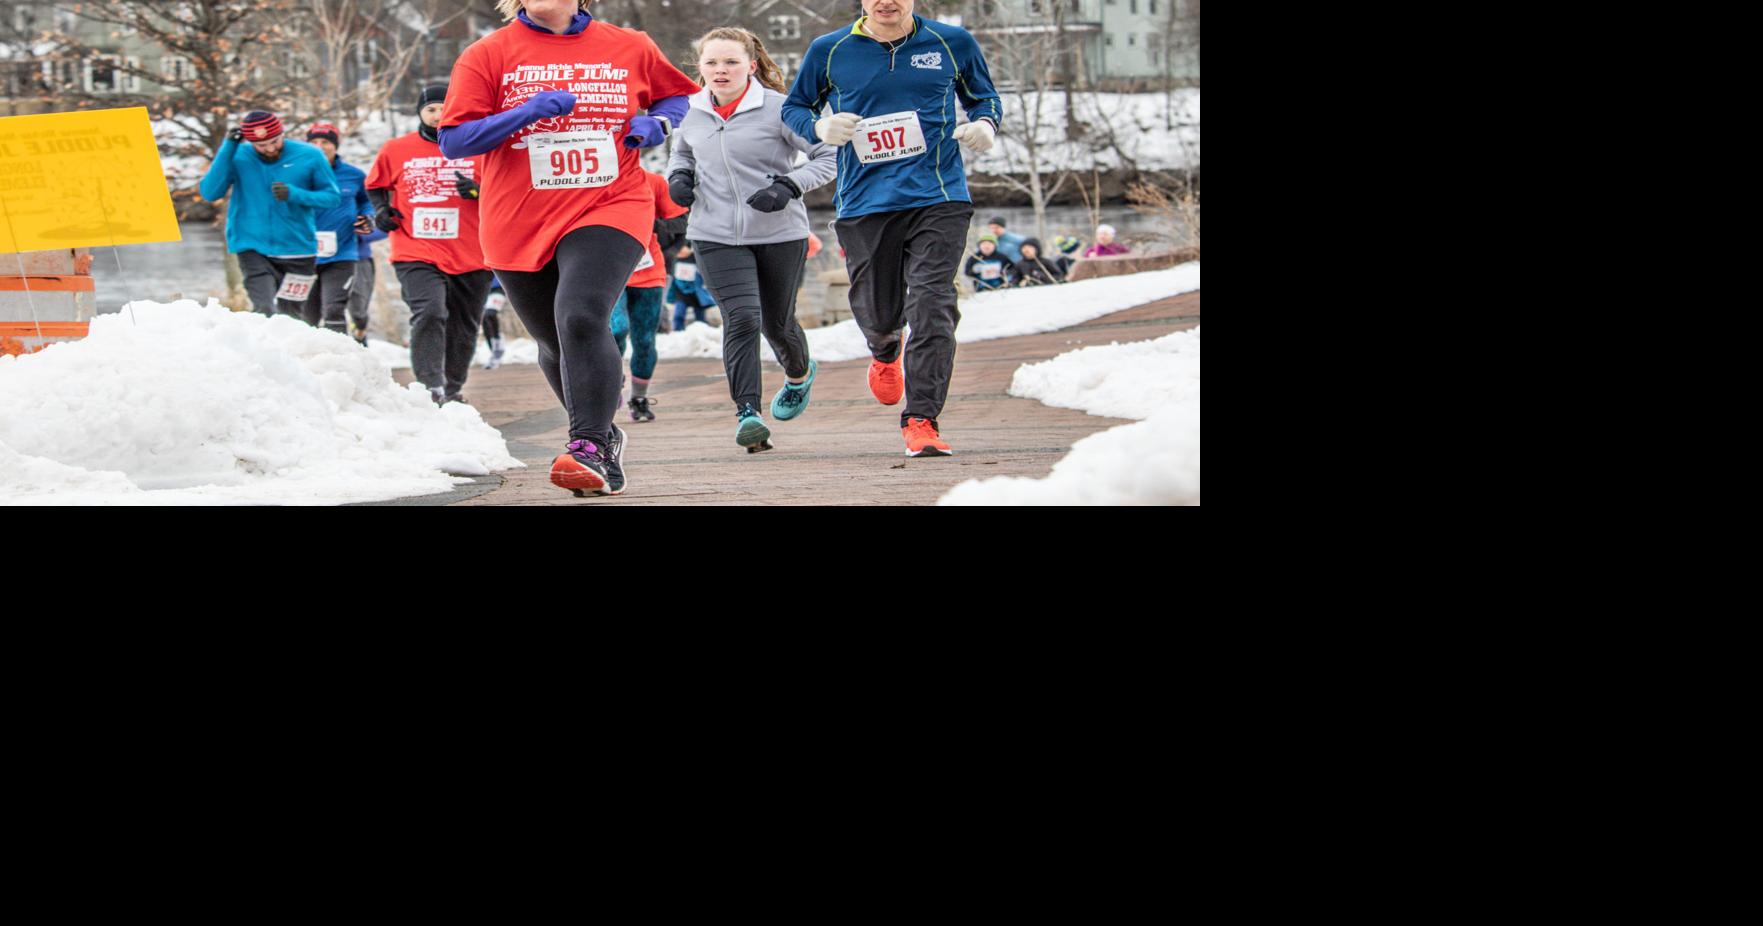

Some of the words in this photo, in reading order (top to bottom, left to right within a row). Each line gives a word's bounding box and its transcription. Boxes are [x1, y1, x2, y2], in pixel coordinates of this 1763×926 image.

[502, 69, 575, 86] PUDDLE
[579, 68, 629, 80] JUMP
[515, 85, 544, 95] 13th
[575, 93, 628, 105] LEMENTARY
[867, 126, 905, 152] 507
[864, 151, 896, 160] PUDDLE
[899, 146, 922, 155] JUMP
[550, 148, 599, 176] 905
[540, 178, 580, 186] PUDDLE
[584, 175, 613, 184] JUMP
[423, 217, 447, 231] 841
